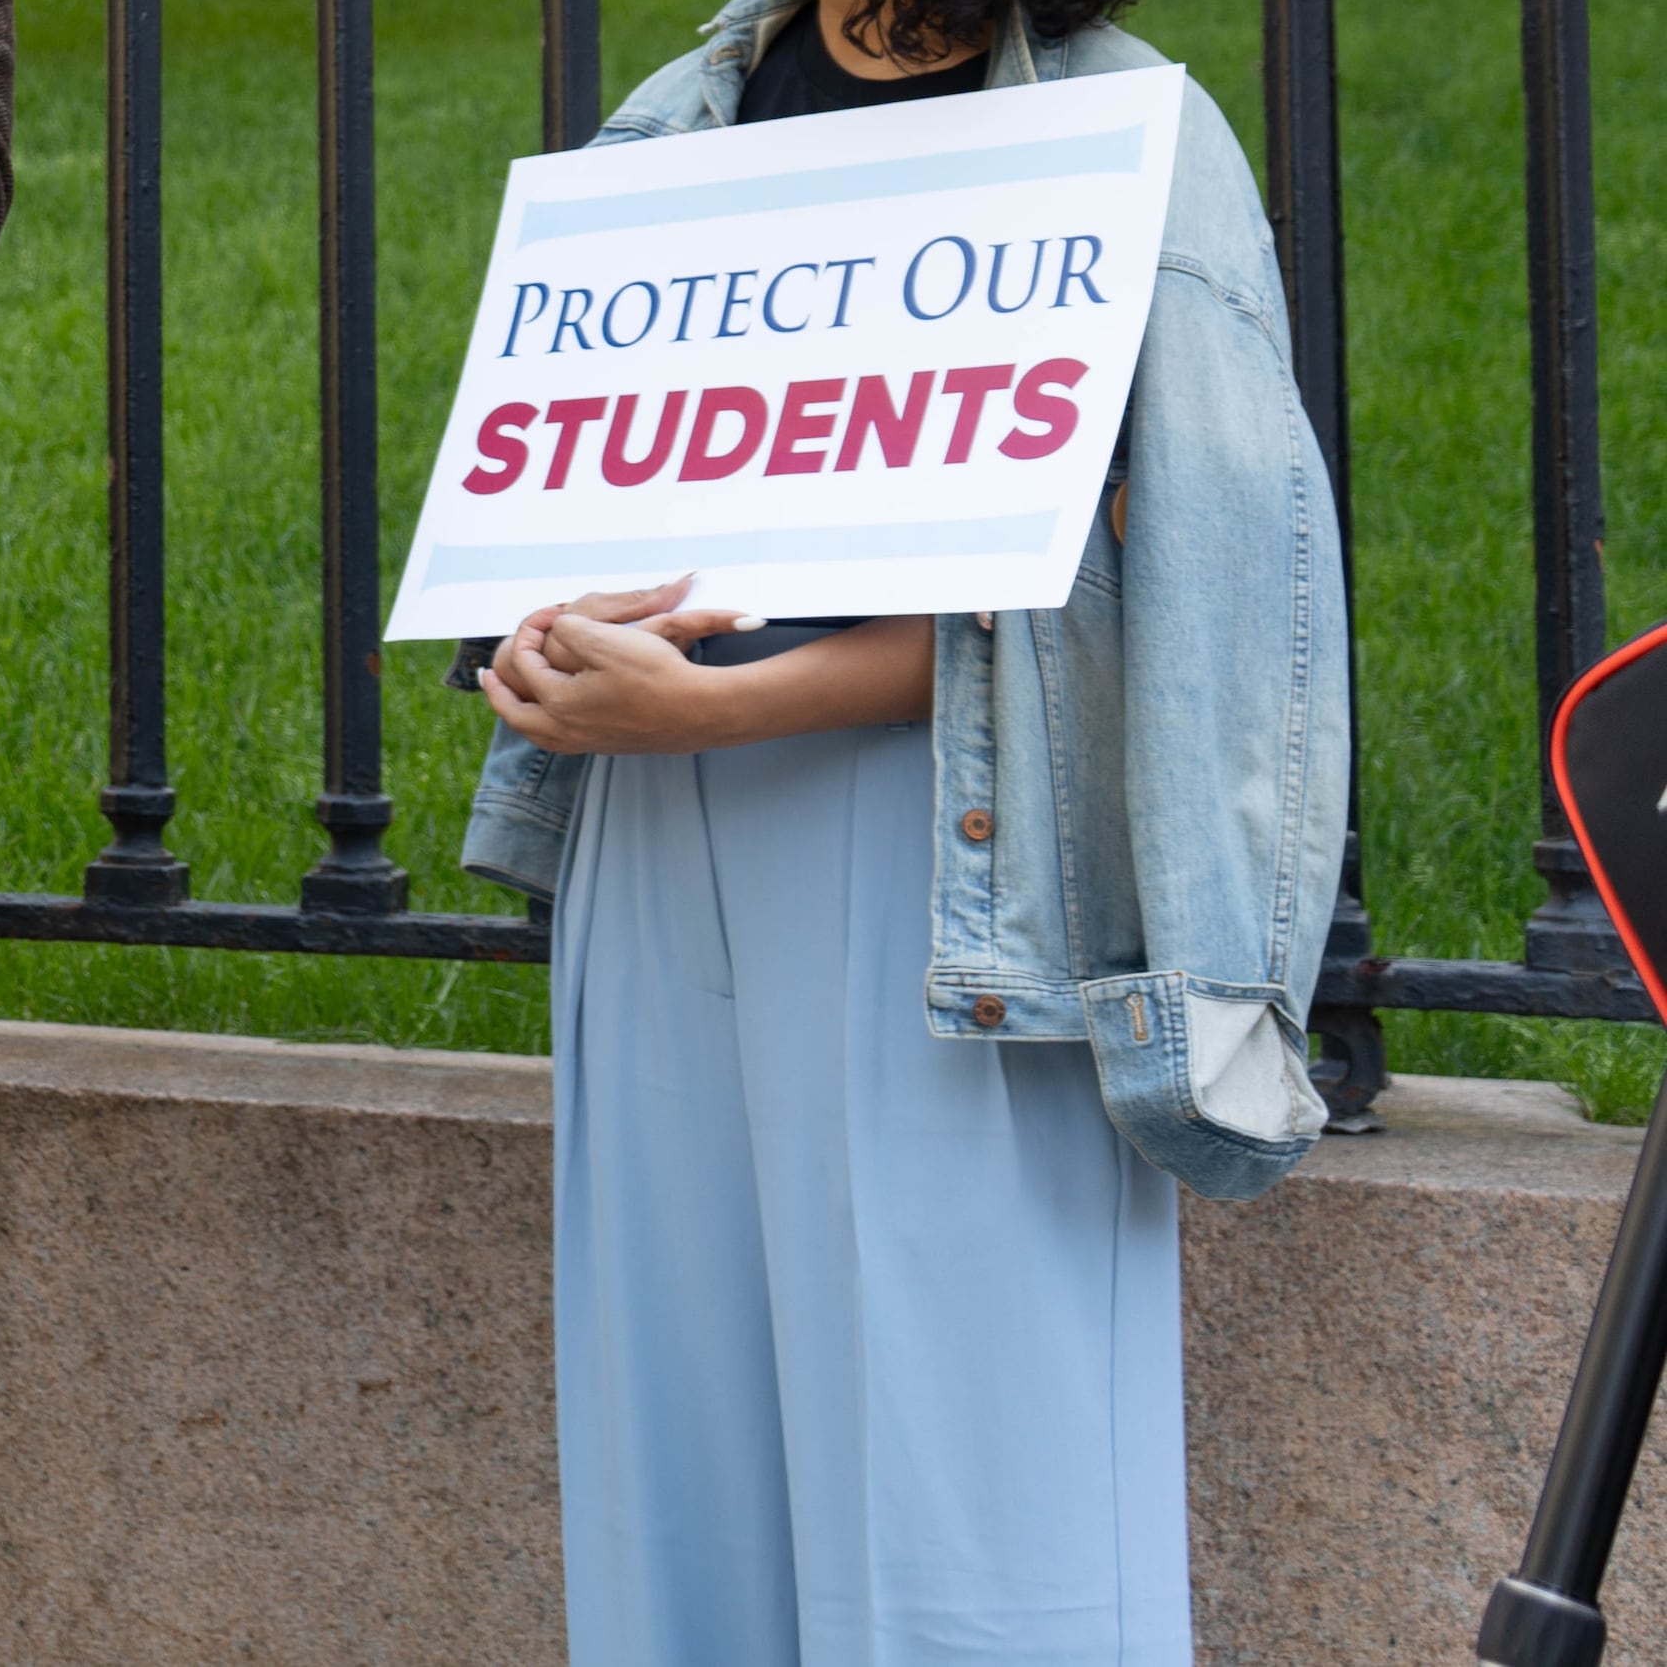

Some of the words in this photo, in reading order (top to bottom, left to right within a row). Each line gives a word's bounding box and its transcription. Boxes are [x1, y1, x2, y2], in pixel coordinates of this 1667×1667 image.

[498, 257, 876, 359] PROTECT
[902, 234, 1109, 321] OUR
[462, 358, 1089, 495] STUDENTS
